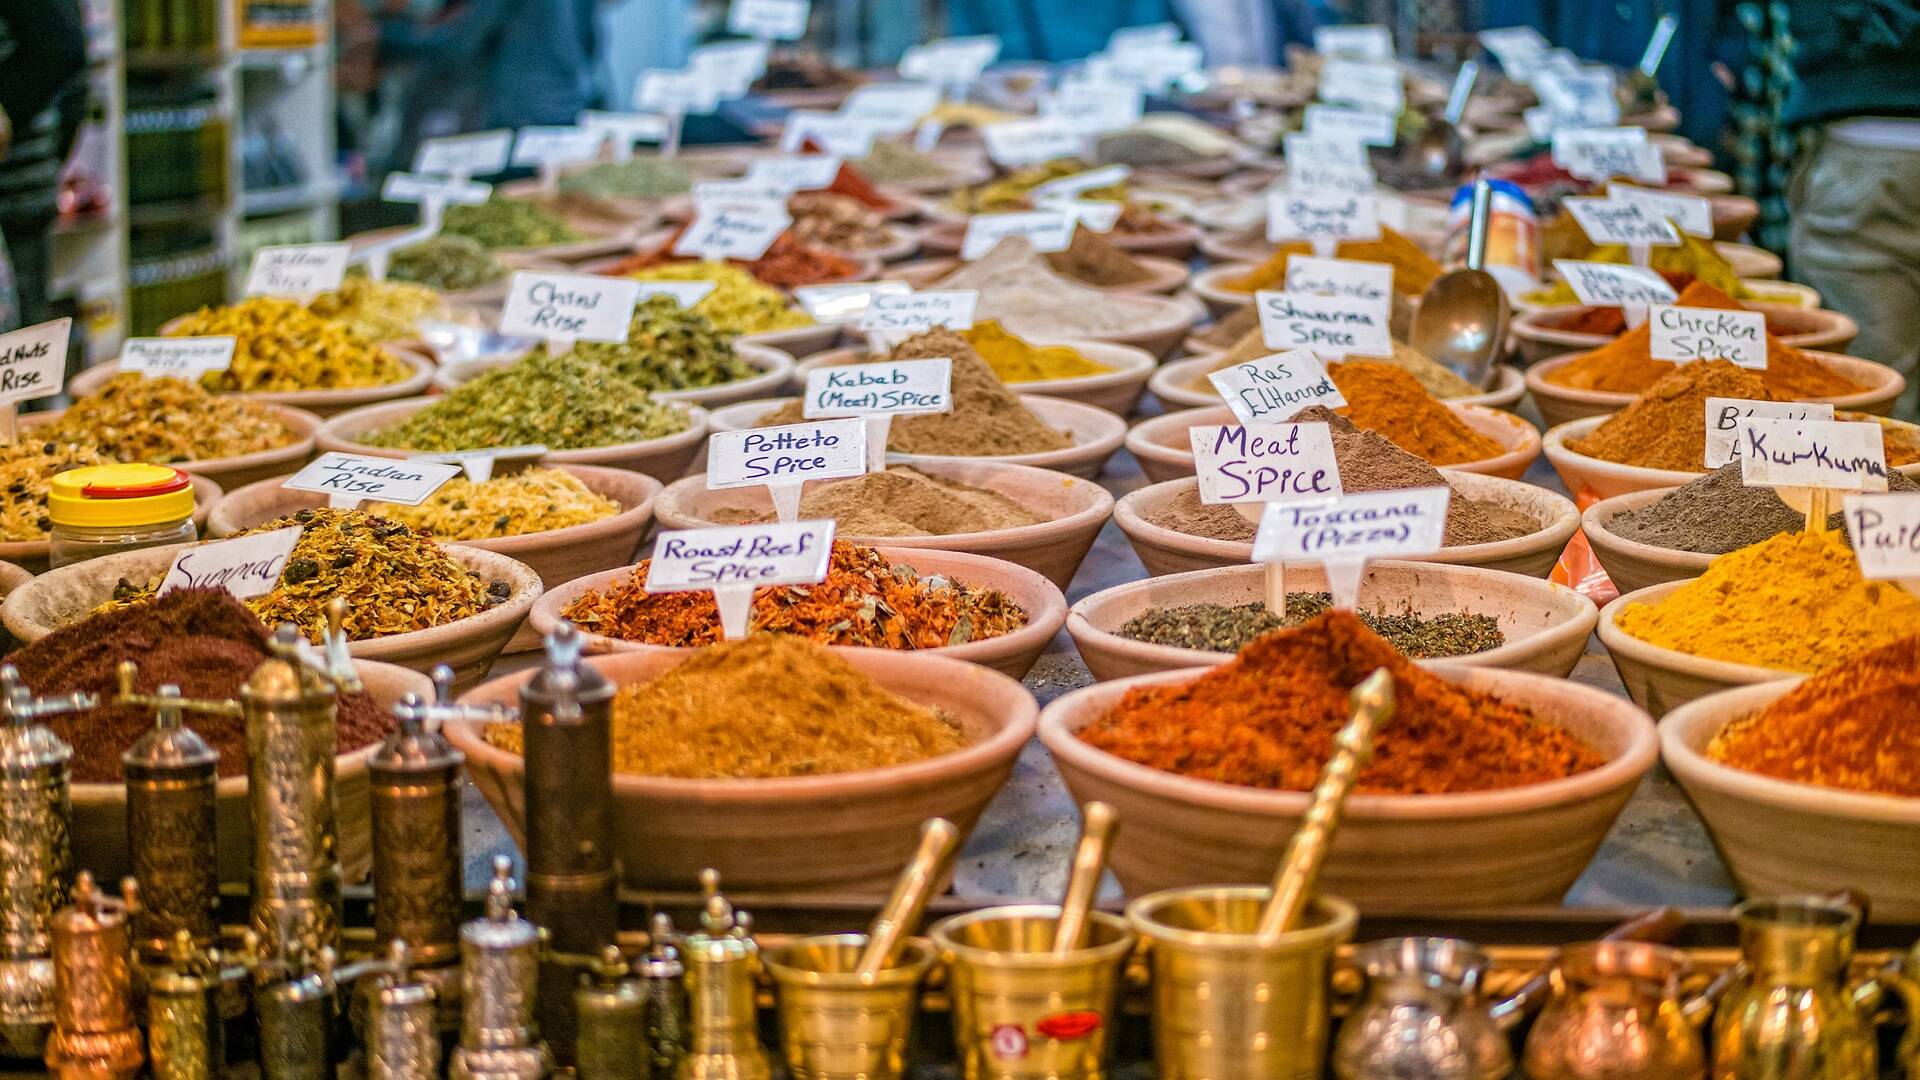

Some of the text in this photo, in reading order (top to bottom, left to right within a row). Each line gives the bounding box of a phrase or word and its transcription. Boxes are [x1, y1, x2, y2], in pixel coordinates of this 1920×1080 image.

[1, 367, 43, 391] Rise
[827, 369, 908, 387] Kabab
[1239, 364, 1293, 383] Ras
[743, 429, 840, 453] Potteto
[1213, 424, 1301, 457] Meat
[320, 472, 386, 493] Rise
[745, 532, 814, 559] Beef
